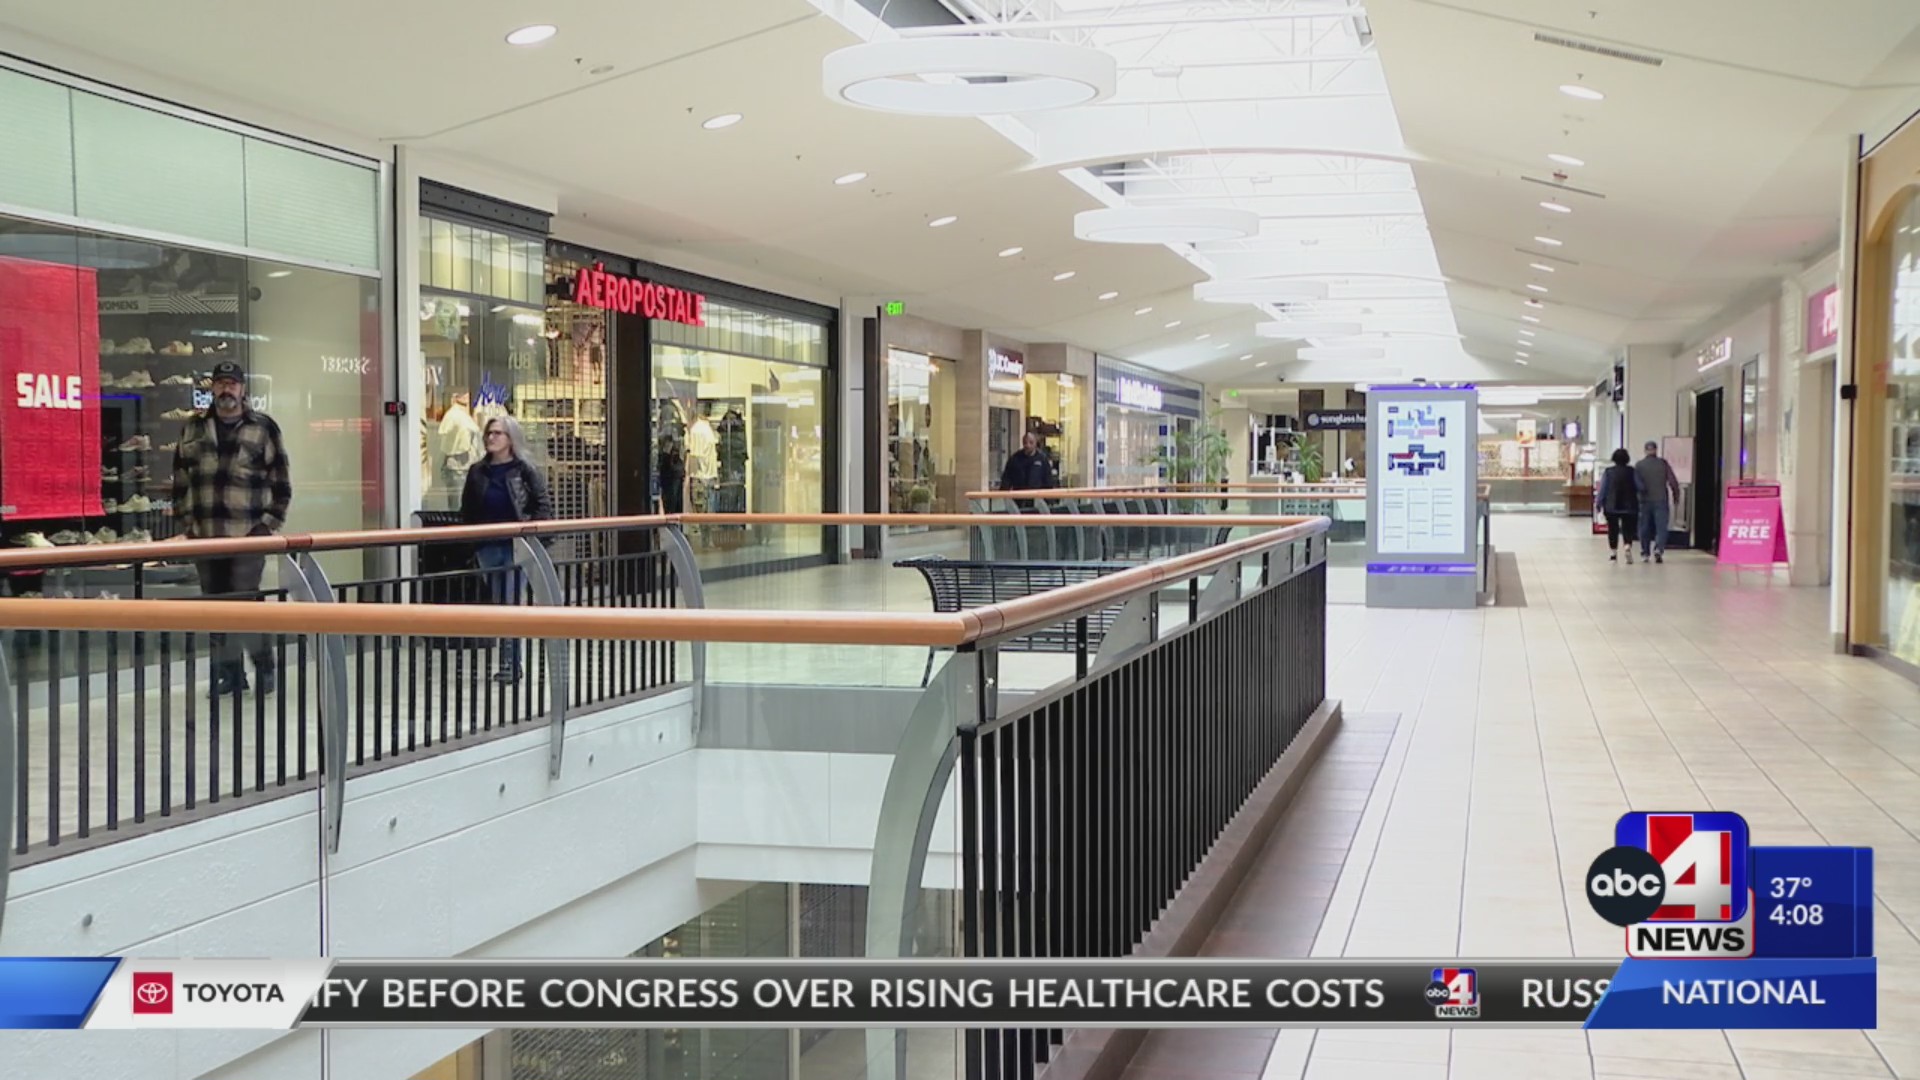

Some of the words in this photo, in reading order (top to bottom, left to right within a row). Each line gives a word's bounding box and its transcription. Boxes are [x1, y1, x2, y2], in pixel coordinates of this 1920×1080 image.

[577, 262, 705, 327] AÉROPOSTALE
[16, 374, 82, 409] SALE
[1727, 525, 1771, 539] FREE
